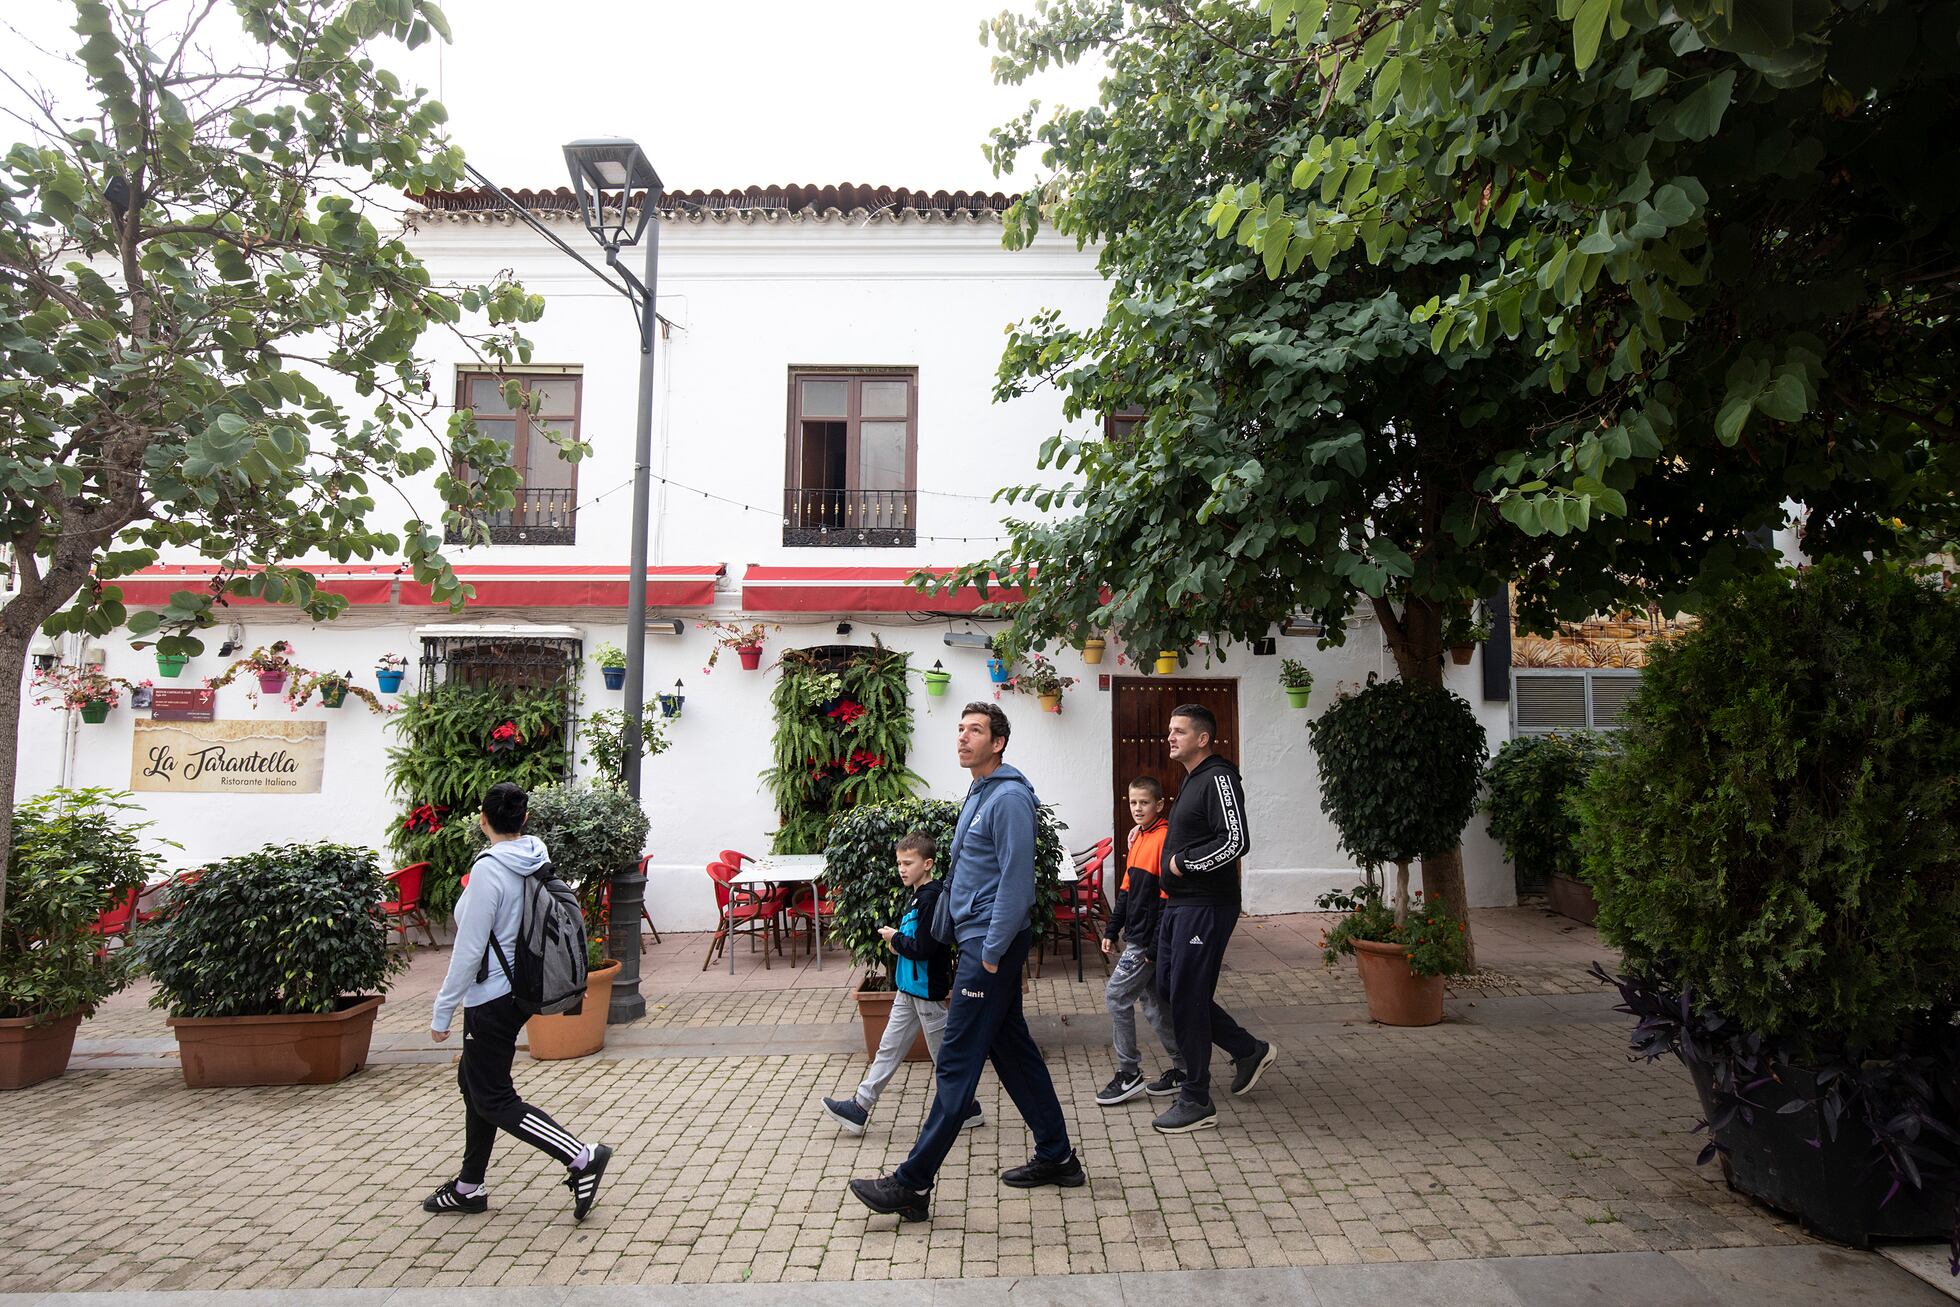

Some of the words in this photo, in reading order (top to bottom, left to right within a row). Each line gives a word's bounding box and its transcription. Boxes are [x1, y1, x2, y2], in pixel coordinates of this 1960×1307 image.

[1260, 639, 1269, 654] 7
[143, 745, 178, 783] La
[184, 745, 299, 780] Tarantella
[221, 776, 263, 787] Ristorante
[265, 776, 297, 787] Italiano
[1218, 775, 1233, 807] adidas
[1227, 809, 1240, 841] adidas
[1214, 841, 1239, 862] adidas
